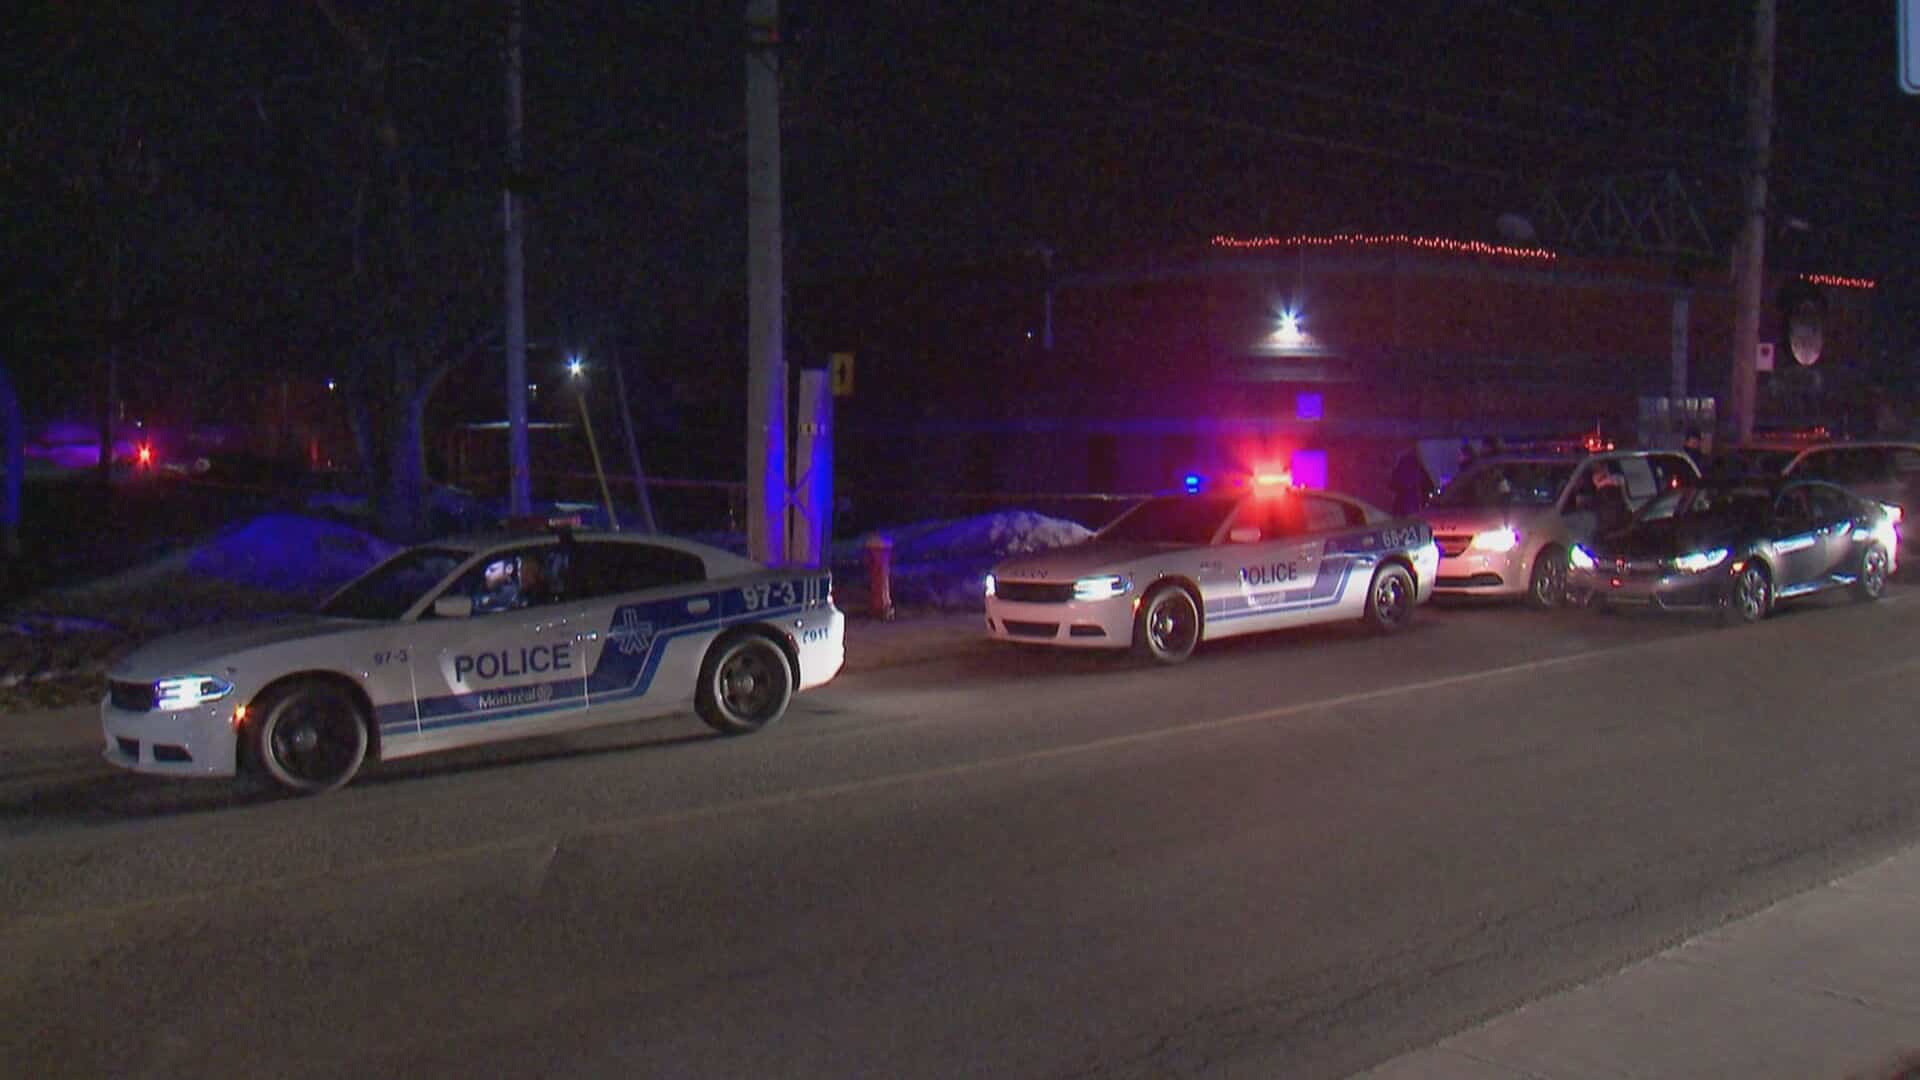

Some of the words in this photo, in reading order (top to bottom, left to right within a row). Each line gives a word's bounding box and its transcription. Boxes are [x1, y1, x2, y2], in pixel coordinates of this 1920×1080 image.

[743, 580, 796, 610] 97-3
[373, 650, 408, 665] 97-3
[455, 644, 571, 683] POLICE
